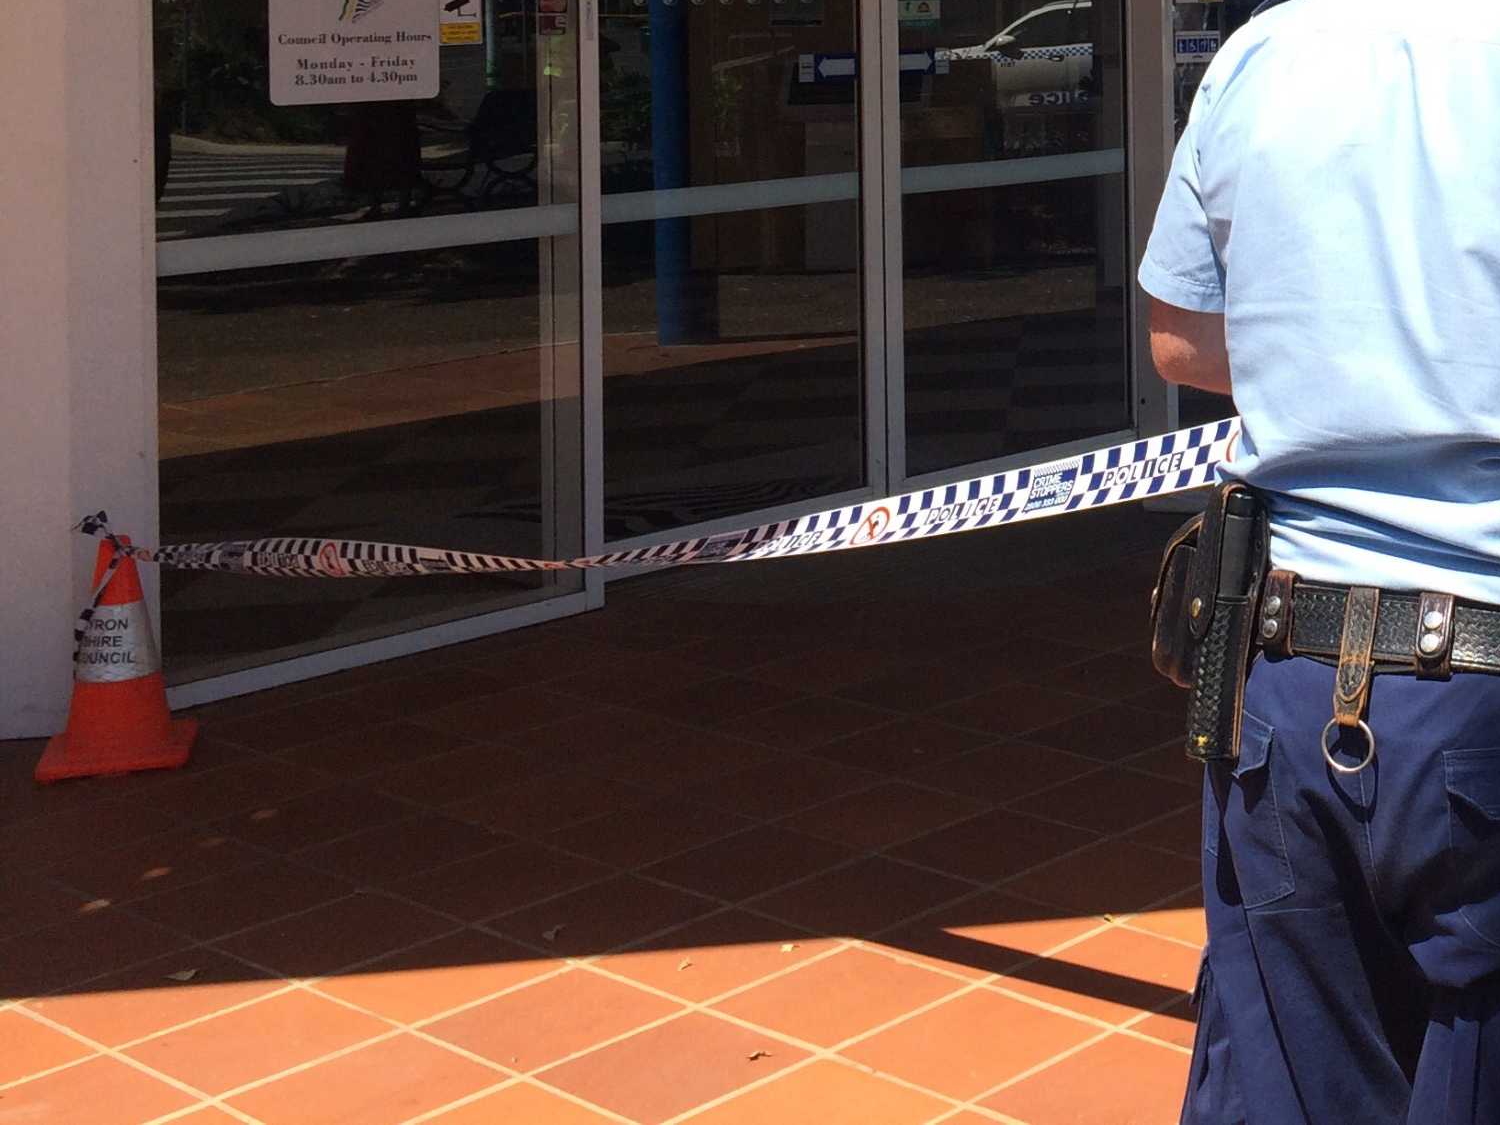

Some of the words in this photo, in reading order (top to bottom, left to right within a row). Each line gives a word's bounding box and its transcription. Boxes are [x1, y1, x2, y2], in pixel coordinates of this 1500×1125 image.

[278, 33, 327, 44] Council
[331, 32, 392, 47] Operating
[396, 31, 432, 43] Hours
[297, 57, 353, 71] Monday
[371, 56, 416, 69] Friday
[294, 74, 347, 86] 8.30am
[351, 74, 364, 84] to
[1103, 452, 1184, 488] POLICE
[1034, 472, 1063, 489] CRIME
[1030, 480, 1073, 499] STOPPERS
[923, 496, 1000, 526] POLICE
